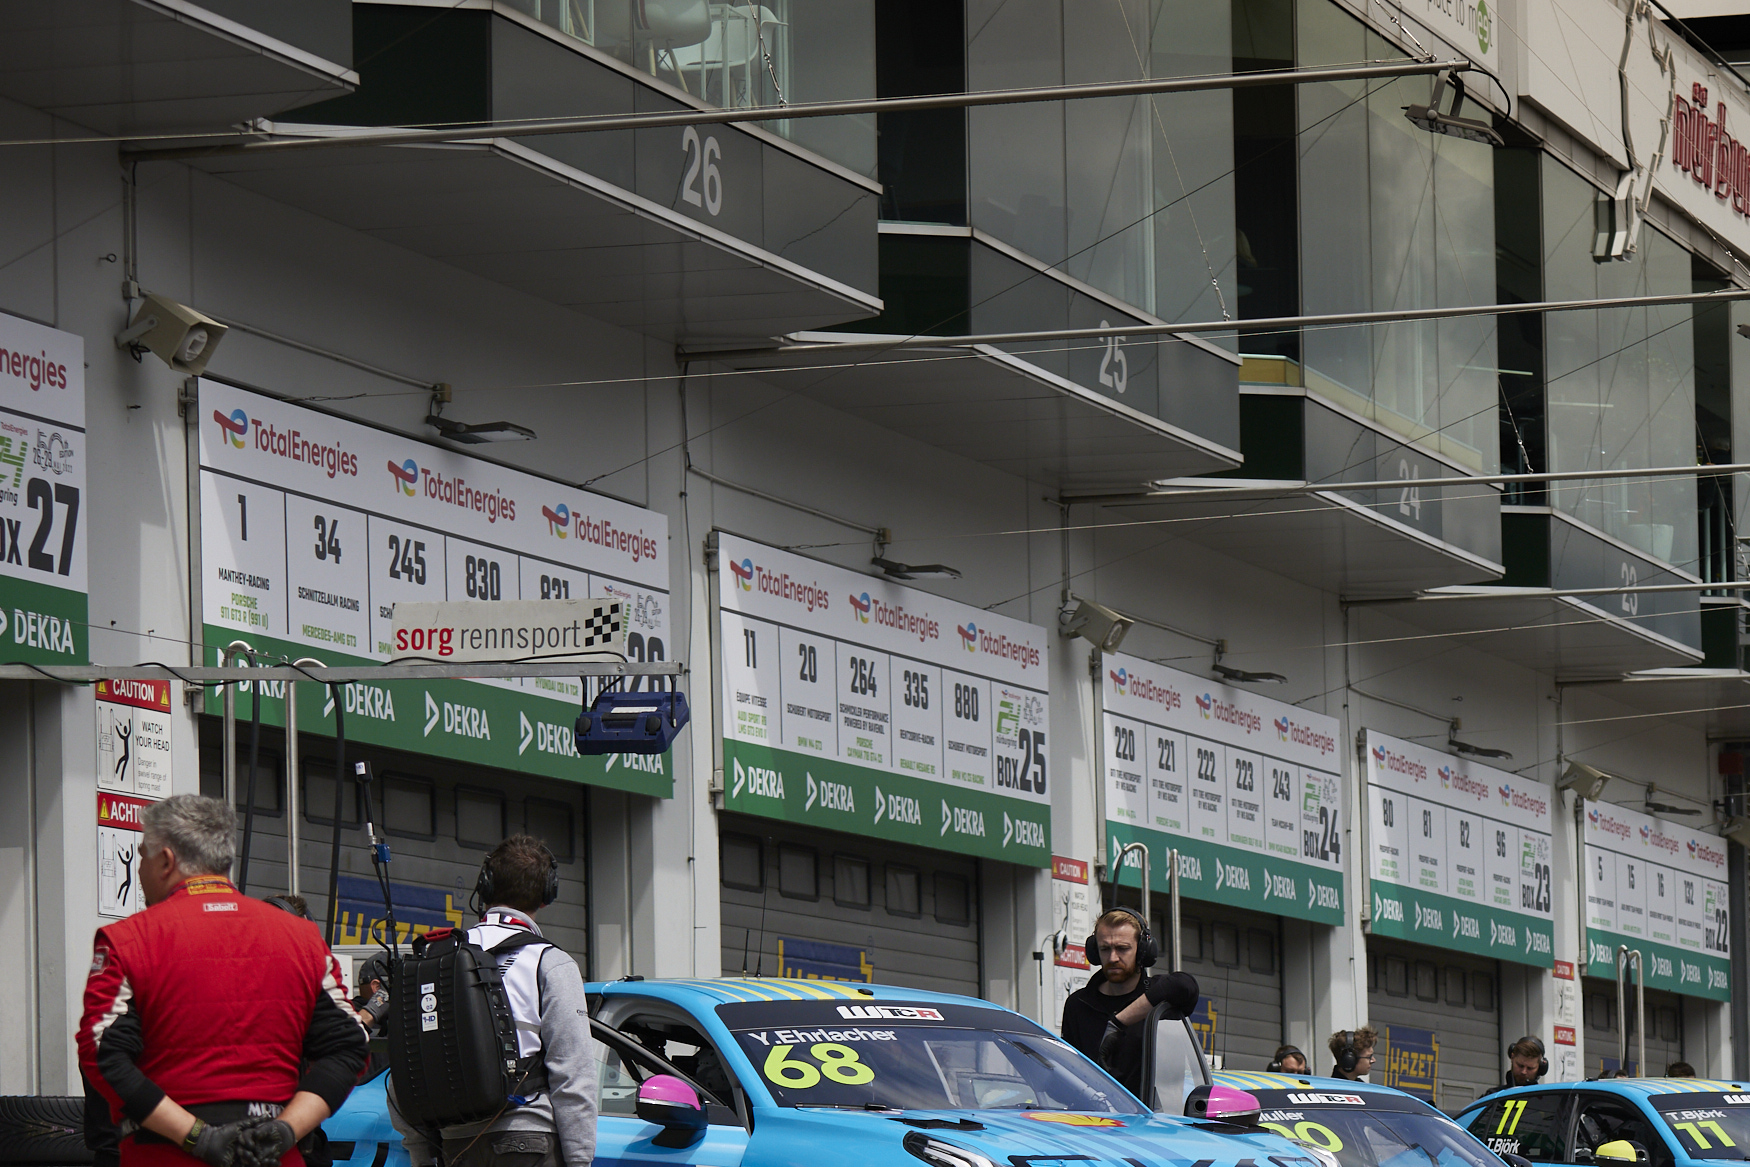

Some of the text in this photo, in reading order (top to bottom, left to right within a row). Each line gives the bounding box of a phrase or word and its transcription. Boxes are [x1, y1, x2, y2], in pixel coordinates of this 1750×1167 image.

[682, 125, 722, 216] 26
[1098, 319, 1128, 394] 25
[251, 418, 358, 479] TotalEnergies
[420, 468, 516, 524] TotalEnergies
[1400, 459, 1421, 521] 24
[27, 477, 80, 577] 27
[237, 493, 247, 542] 1
[314, 514, 342, 564] 34
[572, 511, 657, 562] TotalEnergies
[388, 534, 427, 586] 245
[218, 567, 270, 591] MANTHEY-RACING
[465, 555, 501, 600] 830
[755, 565, 829, 613] TotalEnergies
[1621, 562, 1638, 616] 23
[220, 605, 242, 623] 911 GT3
[231, 592, 258, 610] PORSCHE
[297, 586, 339, 608] SCHNITZELALM
[339, 596, 360, 612] RACING
[14, 607, 76, 655] DEKRA
[302, 624, 357, 648] MERCEDES-AMG GT3
[872, 598, 939, 643] TotalEnergies
[396, 620, 581, 657] sorg rennsport
[743, 628, 757, 669] 11
[978, 628, 1040, 669] TotalEnergies
[799, 643, 818, 683] 20
[850, 656, 877, 698] 264
[112, 677, 155, 702] CAUTION
[346, 683, 396, 721] DEKRA
[904, 670, 929, 710] 335
[954, 683, 979, 722] 880
[1128, 673, 1182, 712] TotalEnergies
[142, 720, 163, 736] WATCH
[444, 701, 491, 740] DEKRA
[1212, 698, 1262, 735] TotalEnergies
[135, 734, 170, 753] YOUR HEAD
[537, 721, 581, 759] DEKRA
[1114, 725, 1135, 762] 220
[1289, 721, 1335, 756] TotalEnergies
[997, 727, 1047, 795] BOX 25
[1158, 737, 1176, 773] 221
[1197, 748, 1216, 783] 222
[1386, 751, 1427, 783] TotalEnergies
[748, 765, 785, 800] DEKRA
[1235, 758, 1254, 792] 223
[1273, 768, 1291, 802] 243
[1450, 770, 1489, 801] TotalEnergies
[820, 780, 855, 813] DEKRA
[888, 794, 922, 826] DEKRA
[1510, 788, 1547, 818] TotalEnergies
[953, 806, 986, 838] DEKRA
[1382, 798, 1394, 828] 80
[1423, 809, 1432, 838] 81
[1599, 813, 1632, 841] TotalEnergies
[1015, 818, 1046, 849] DEKRA
[1303, 806, 1341, 864] BOX 24
[1459, 819, 1470, 849] 82
[1496, 830, 1506, 858] 96
[1649, 829, 1680, 855] TotalEnergies
[1059, 862, 1081, 879] CAUTION
[1178, 854, 1203, 881] DEKRA
[1598, 856, 1603, 881] 5
[1696, 843, 1725, 868] TotalEnergies
[1225, 864, 1250, 891] DEKRA
[1273, 874, 1297, 900] DEKRA
[1522, 862, 1551, 914] BOX 23
[1317, 884, 1340, 910] DEKRA
[1383, 898, 1404, 922] DEKRA
[1422, 907, 1443, 931] DEKRA
[1460, 916, 1480, 939] DEKRA
[1498, 924, 1517, 946] DEKRA
[1705, 908, 1728, 953] BOX 22
[1533, 932, 1551, 954] DEKRA
[1596, 944, 1614, 965] DEKRA
[1657, 957, 1673, 977] DEKRA
[1686, 963, 1702, 983] DEKRA
[1713, 970, 1729, 989] DEKRA
[836, 1005, 945, 1021] WTCR
[748, 1027, 898, 1046] Y.Ehrlacher
[763, 1042, 875, 1089] 68
[1389, 1047, 1435, 1087] HAZET
[1286, 1093, 1366, 1106] WTCR
[1665, 1110, 1727, 1121] T.Björk
[1495, 1100, 1528, 1135] 11
[1487, 1137, 1520, 1155] T.Björk
[1673, 1120, 1737, 1150] 11
